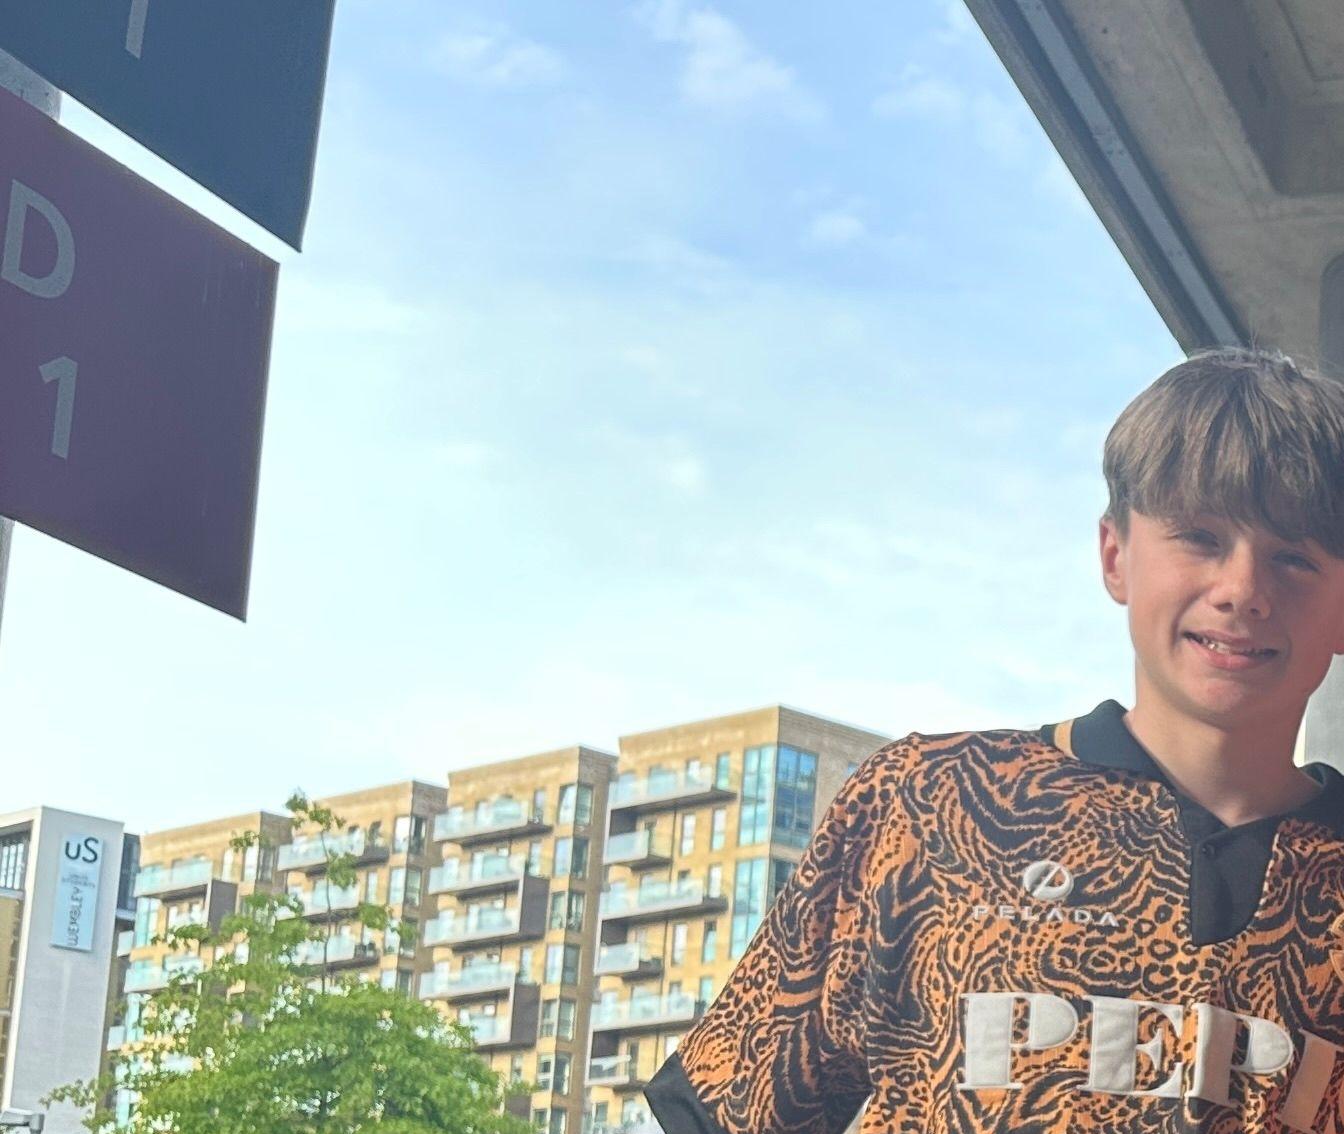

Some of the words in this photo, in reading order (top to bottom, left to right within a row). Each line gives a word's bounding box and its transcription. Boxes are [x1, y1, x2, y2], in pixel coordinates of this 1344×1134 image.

[2, 179, 76, 299] D
[39, 355, 78, 459] 1
[973, 904, 1120, 928] PELADA
